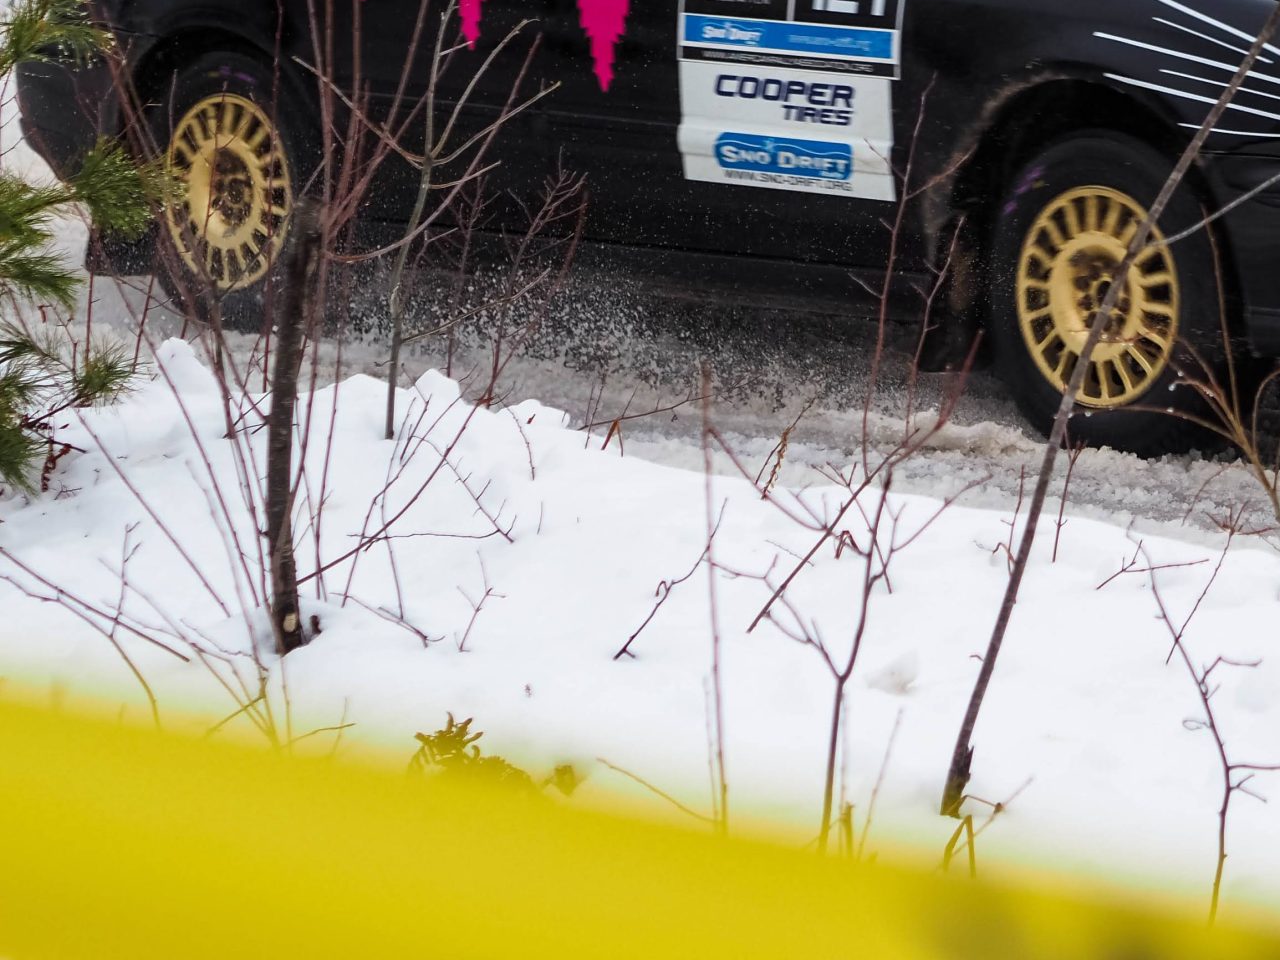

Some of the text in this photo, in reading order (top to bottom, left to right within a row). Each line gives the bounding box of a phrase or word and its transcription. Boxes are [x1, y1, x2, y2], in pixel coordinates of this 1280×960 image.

[714, 74, 855, 108] COOPER
[782, 104, 855, 126] TIRES
[720, 145, 849, 172] SNO DRIFT
